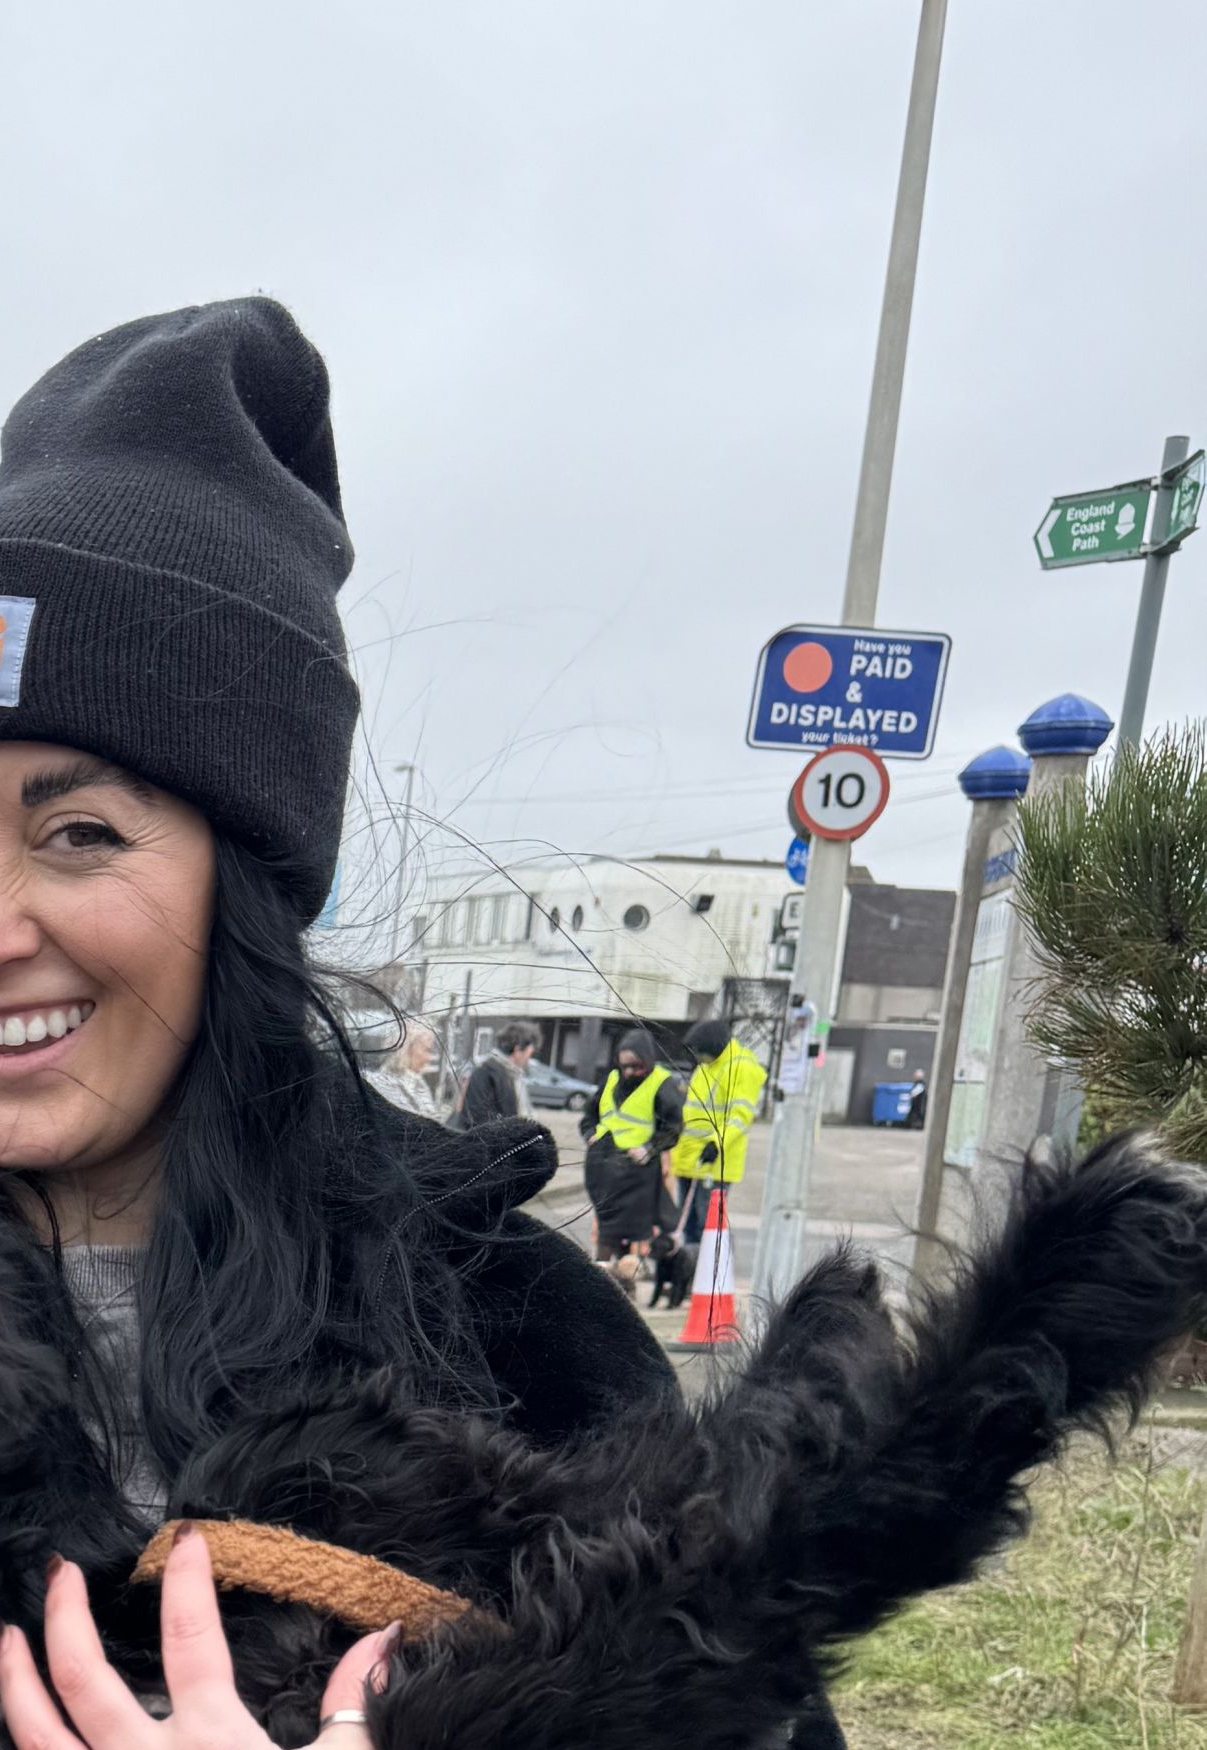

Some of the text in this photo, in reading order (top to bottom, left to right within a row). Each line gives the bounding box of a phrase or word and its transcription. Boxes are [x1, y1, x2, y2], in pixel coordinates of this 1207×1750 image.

[1066, 501, 1115, 522] England
[1071, 519, 1106, 536] Coast
[1072, 535, 1100, 551] Path
[853, 638, 912, 655] Have you
[849, 654, 913, 680] PAID
[845, 680, 863, 703] &
[771, 703, 917, 733] DISPLAYED
[801, 731, 830, 743] your
[817, 772, 866, 809] 10
